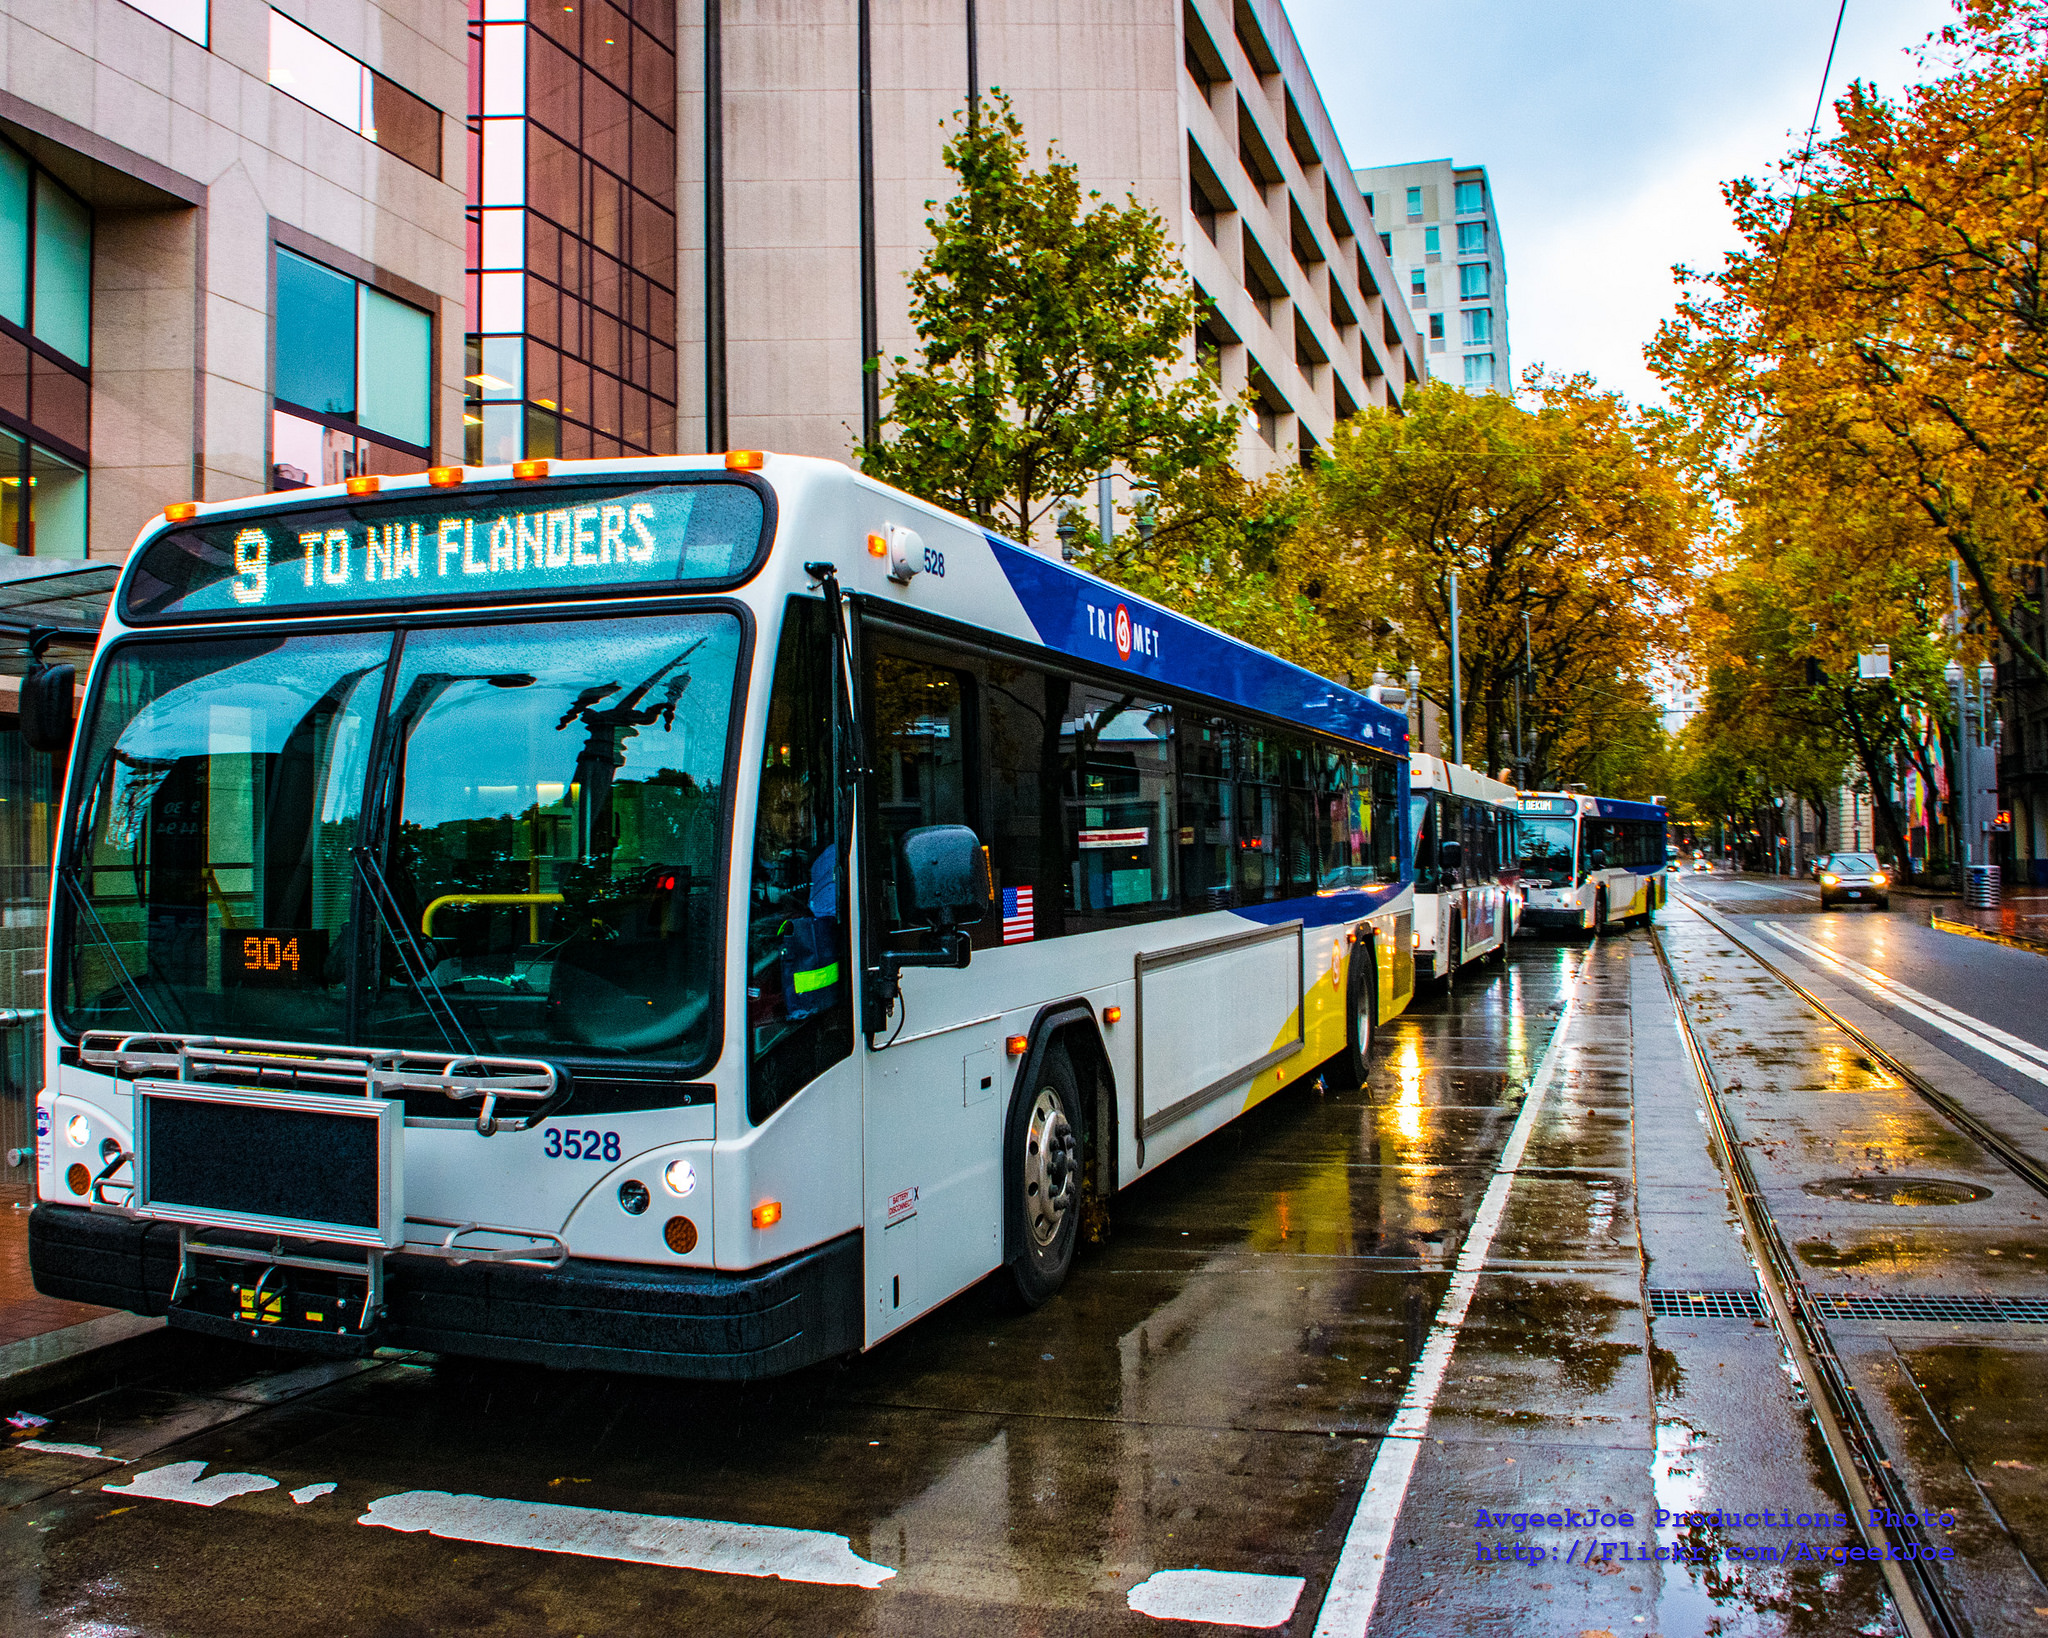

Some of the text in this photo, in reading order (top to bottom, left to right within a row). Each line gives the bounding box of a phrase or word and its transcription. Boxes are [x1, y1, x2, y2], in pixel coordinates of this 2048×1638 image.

[233, 503, 656, 604] 9 TO NW FLANDERS
[924, 547, 945, 578] 528
[1525, 800, 1552, 811] DEKUM
[244, 937, 300, 971] 904
[544, 1127, 622, 1162] 3528
